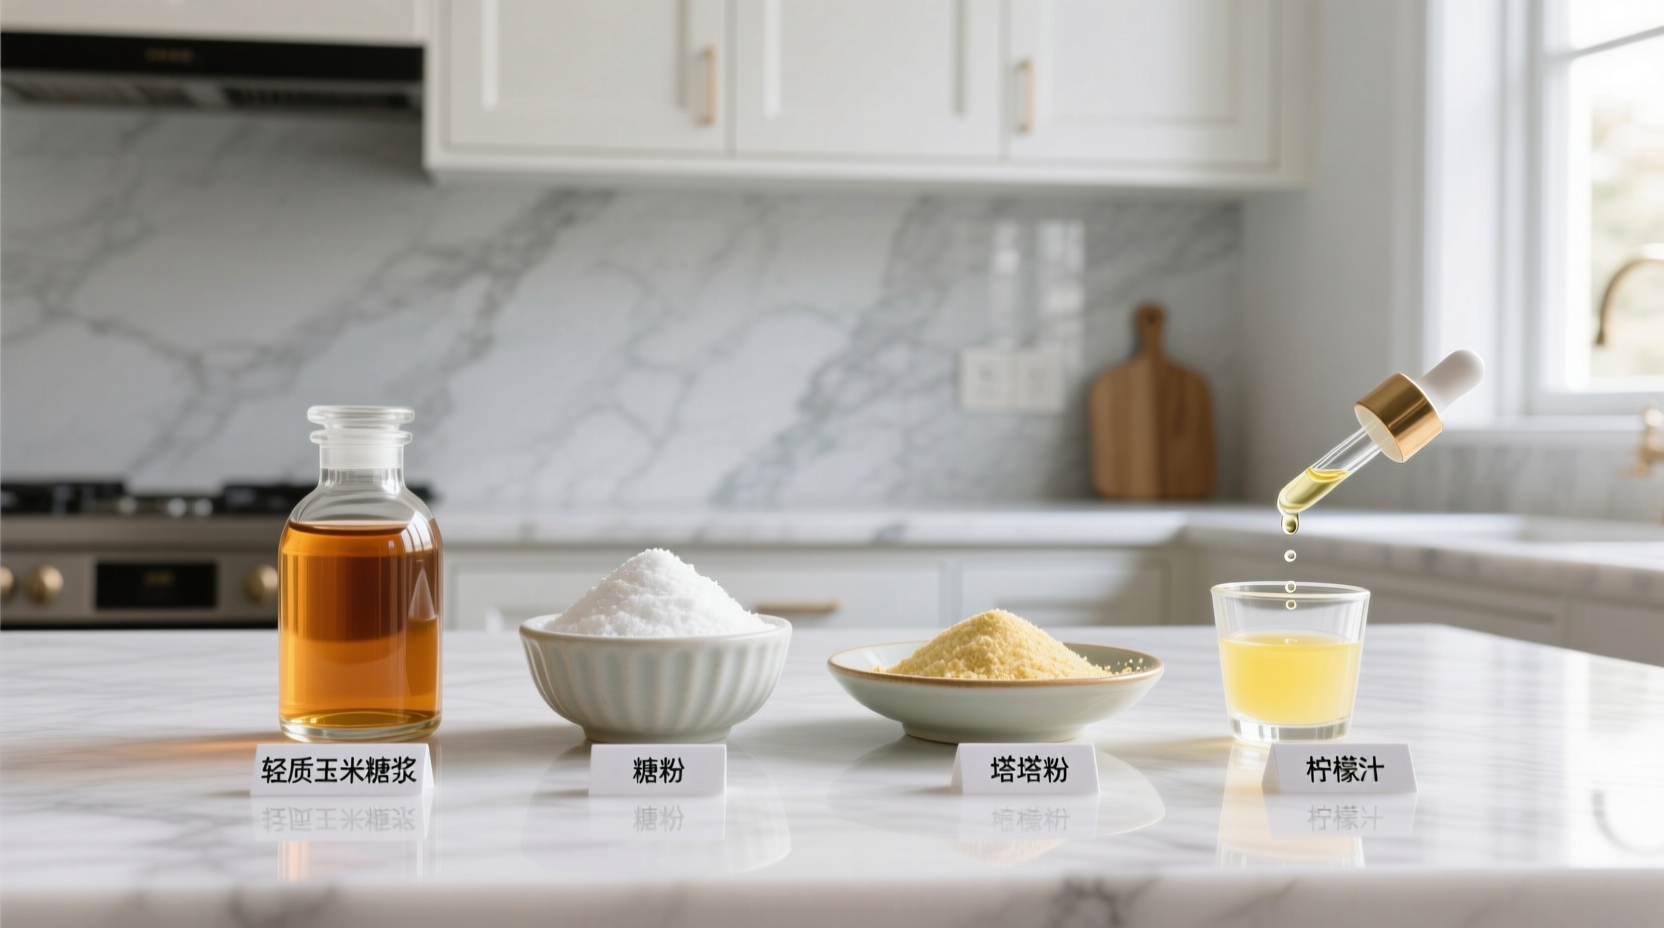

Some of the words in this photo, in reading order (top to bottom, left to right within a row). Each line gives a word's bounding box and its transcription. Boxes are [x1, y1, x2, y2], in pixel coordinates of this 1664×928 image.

[261, 756, 417, 784] 轻质玉米糖浆
[632, 756, 685, 784] 糖粉
[990, 754, 1069, 783] 塔塔粉
[1305, 755, 1385, 783] 柠檬汁
